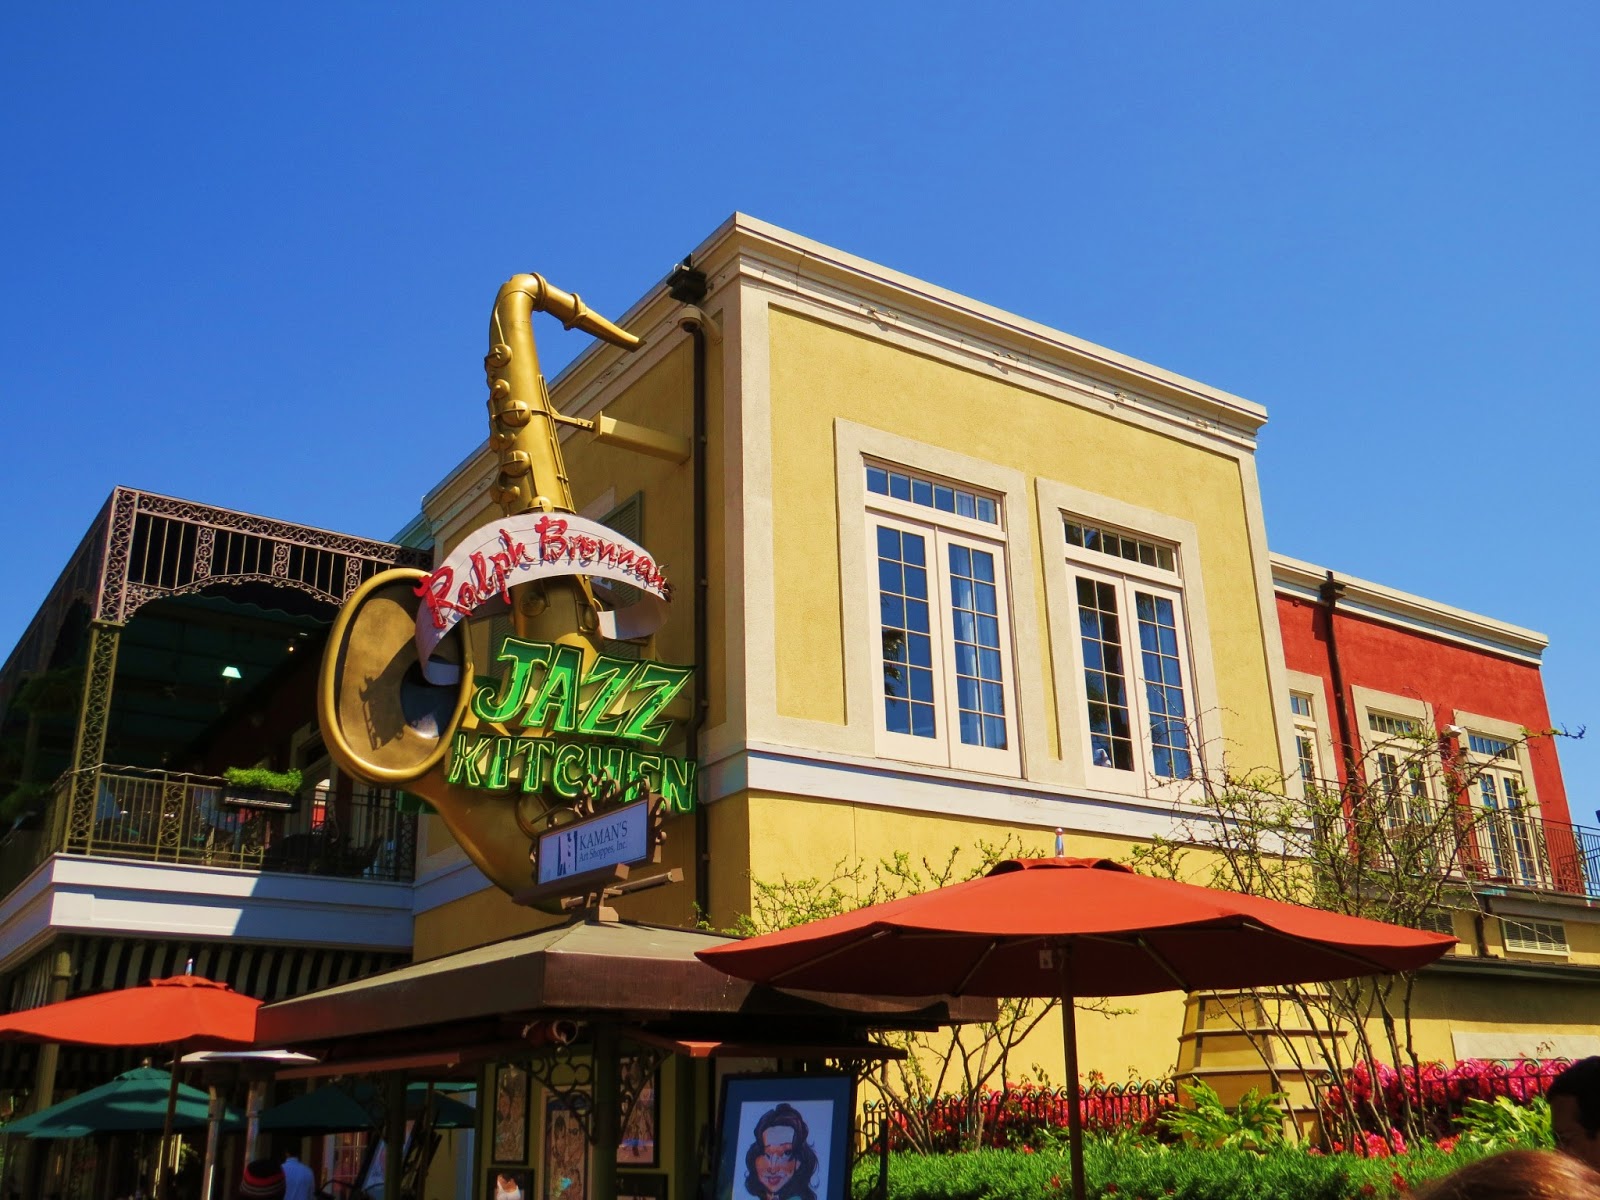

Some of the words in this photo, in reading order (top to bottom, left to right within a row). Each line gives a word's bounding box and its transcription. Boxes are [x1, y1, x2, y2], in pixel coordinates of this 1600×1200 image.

[413, 528, 534, 629] Ralph
[472, 634, 696, 746] JAZZ
[448, 730, 697, 814] KITCHEN
[579, 820, 628, 850] KAMAN'S
[580, 851, 589, 861] Art
